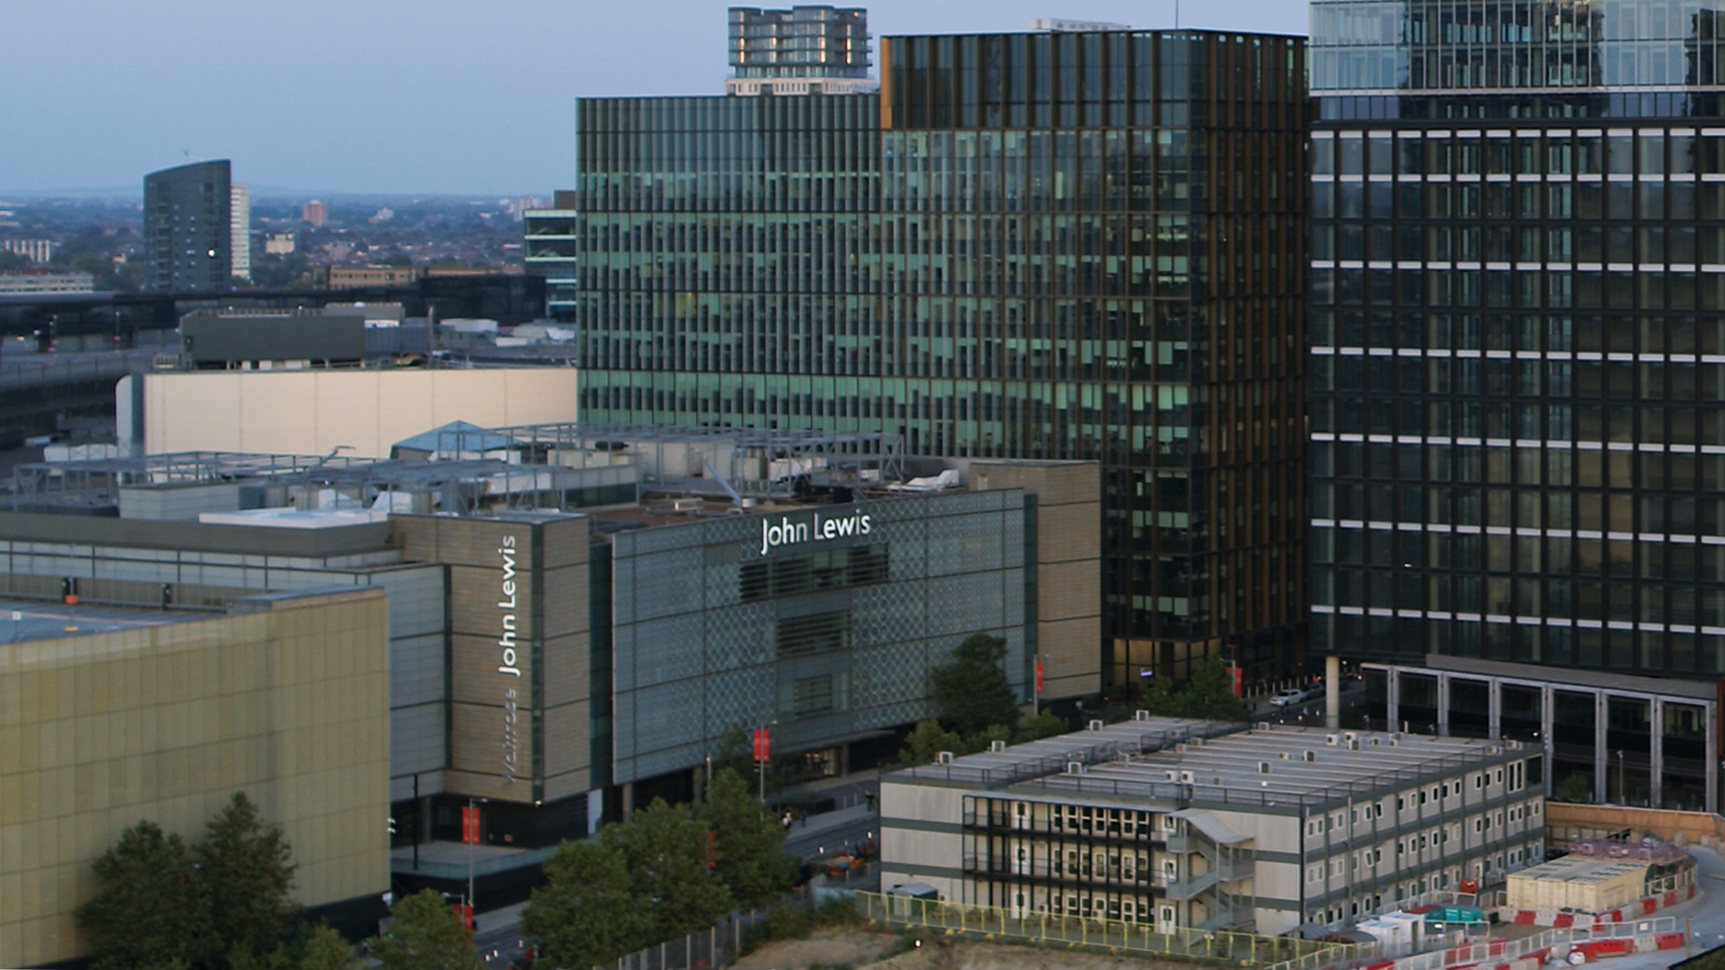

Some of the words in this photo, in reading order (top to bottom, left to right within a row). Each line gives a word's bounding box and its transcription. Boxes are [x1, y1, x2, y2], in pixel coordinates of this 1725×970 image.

[760, 516, 808, 556] John
[814, 509, 870, 540] Lewis
[498, 535, 516, 609] Lewis
[498, 614, 521, 677] John
